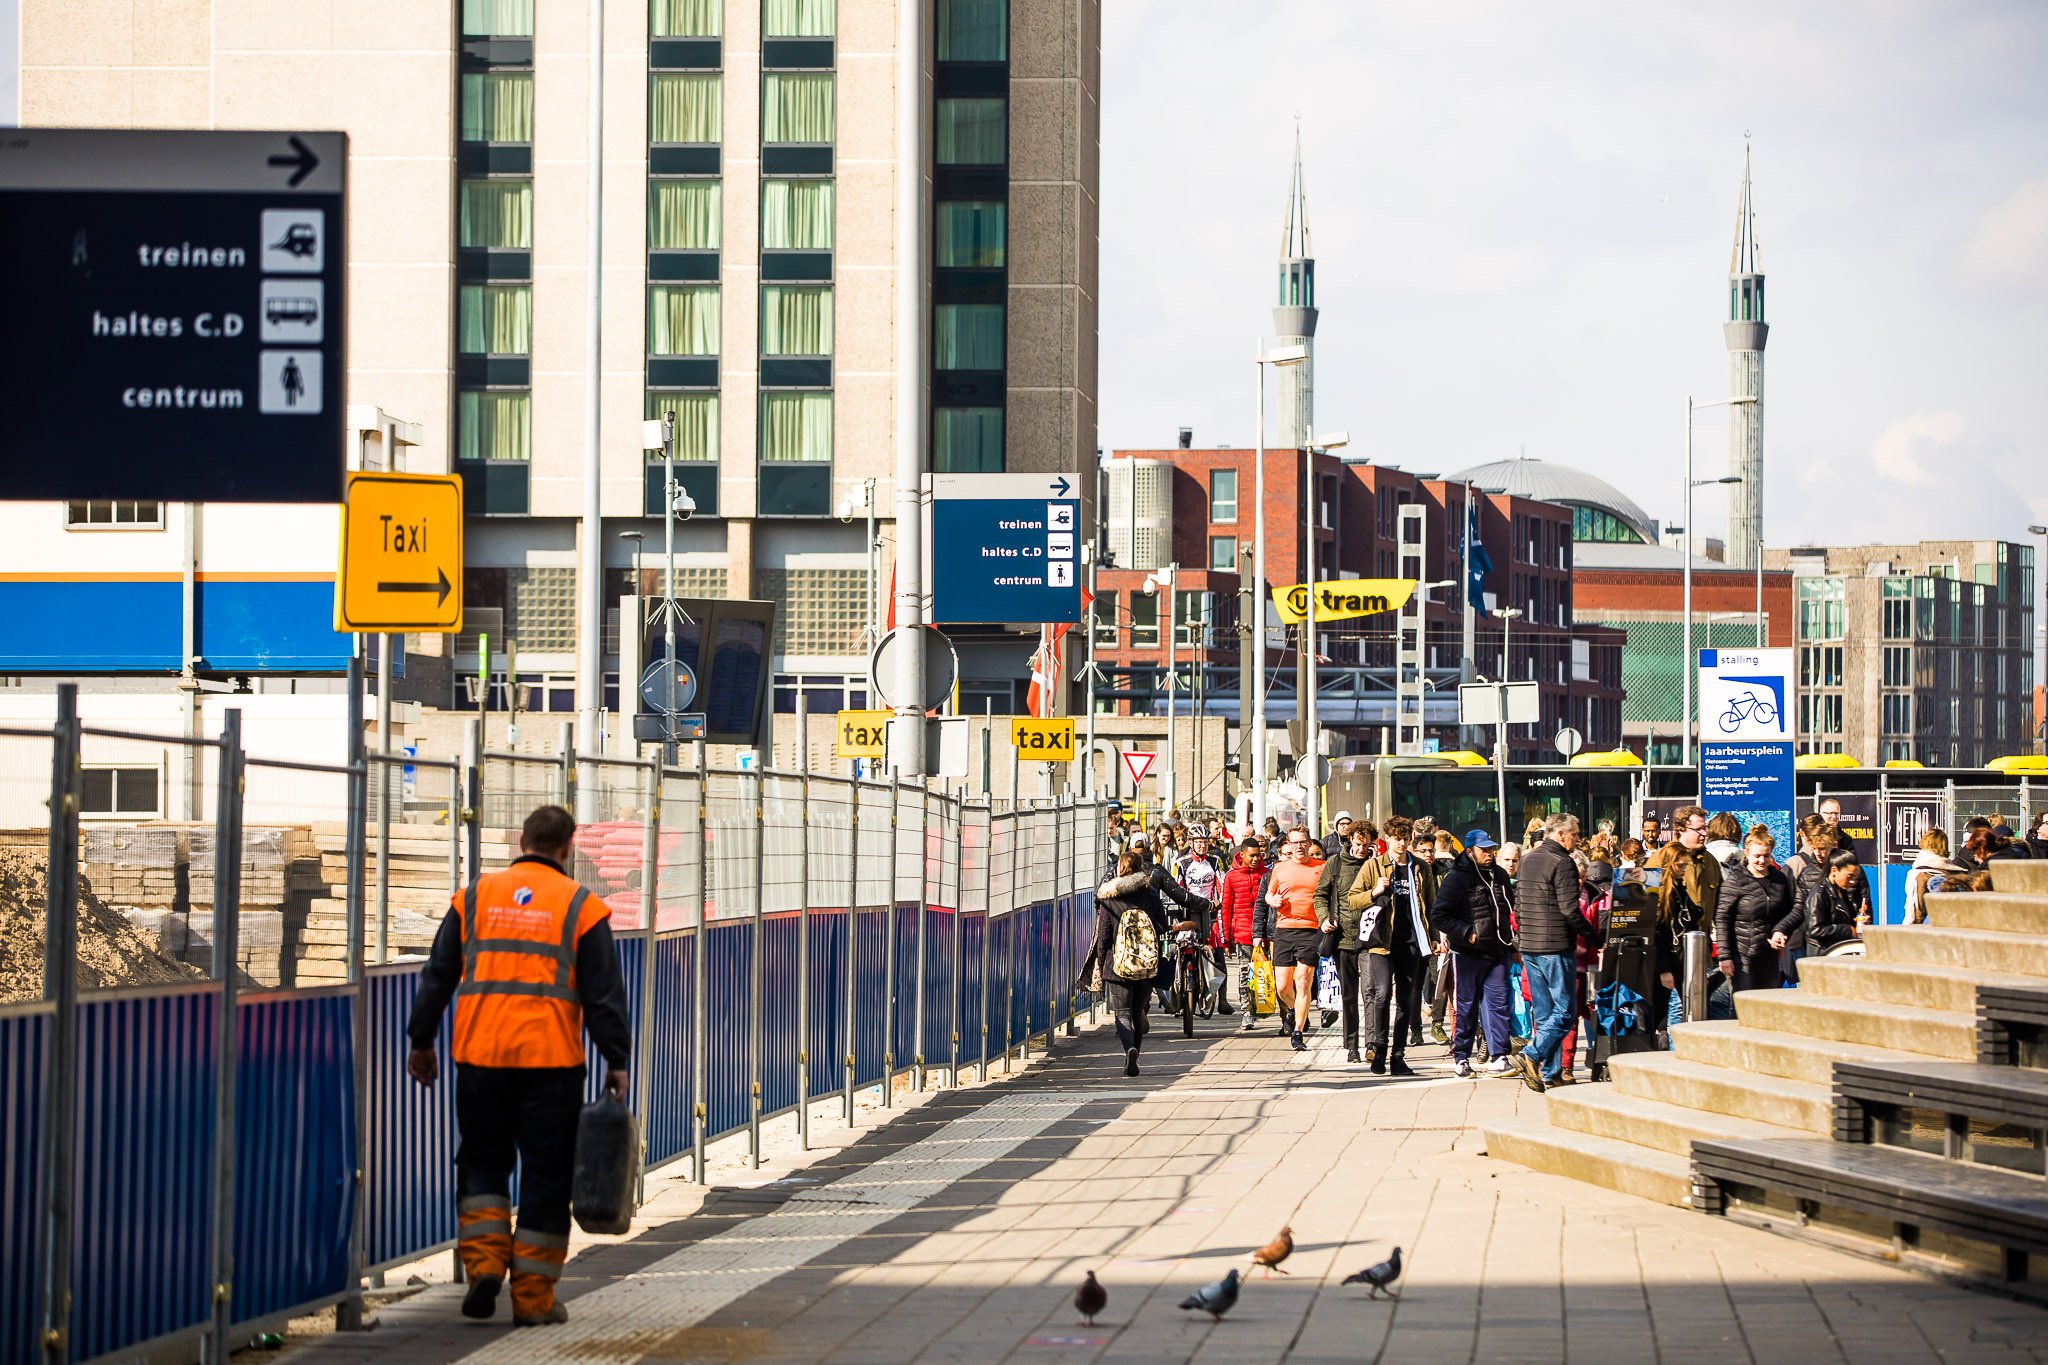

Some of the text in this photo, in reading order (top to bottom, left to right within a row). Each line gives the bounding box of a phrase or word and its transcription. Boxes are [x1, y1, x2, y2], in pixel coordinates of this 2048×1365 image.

[138, 241, 246, 267] treinen
[93, 310, 244, 337] haltes C.D
[122, 385, 244, 408] centrum
[380, 515, 426, 552] Taxi
[999, 520, 1042, 529] treinen
[982, 547, 1042, 557] haltes C.D
[994, 575, 1042, 585] centrum
[1321, 589, 1389, 612] tram
[1721, 655, 1759, 666] stalling
[843, 722, 884, 746] tax
[1017, 726, 1070, 749] taxi
[1705, 746, 1783, 757] Jaarbeursplein
[1528, 776, 1565, 787] u-ov.info
[1257, 967, 1266, 1005] JUMBO
